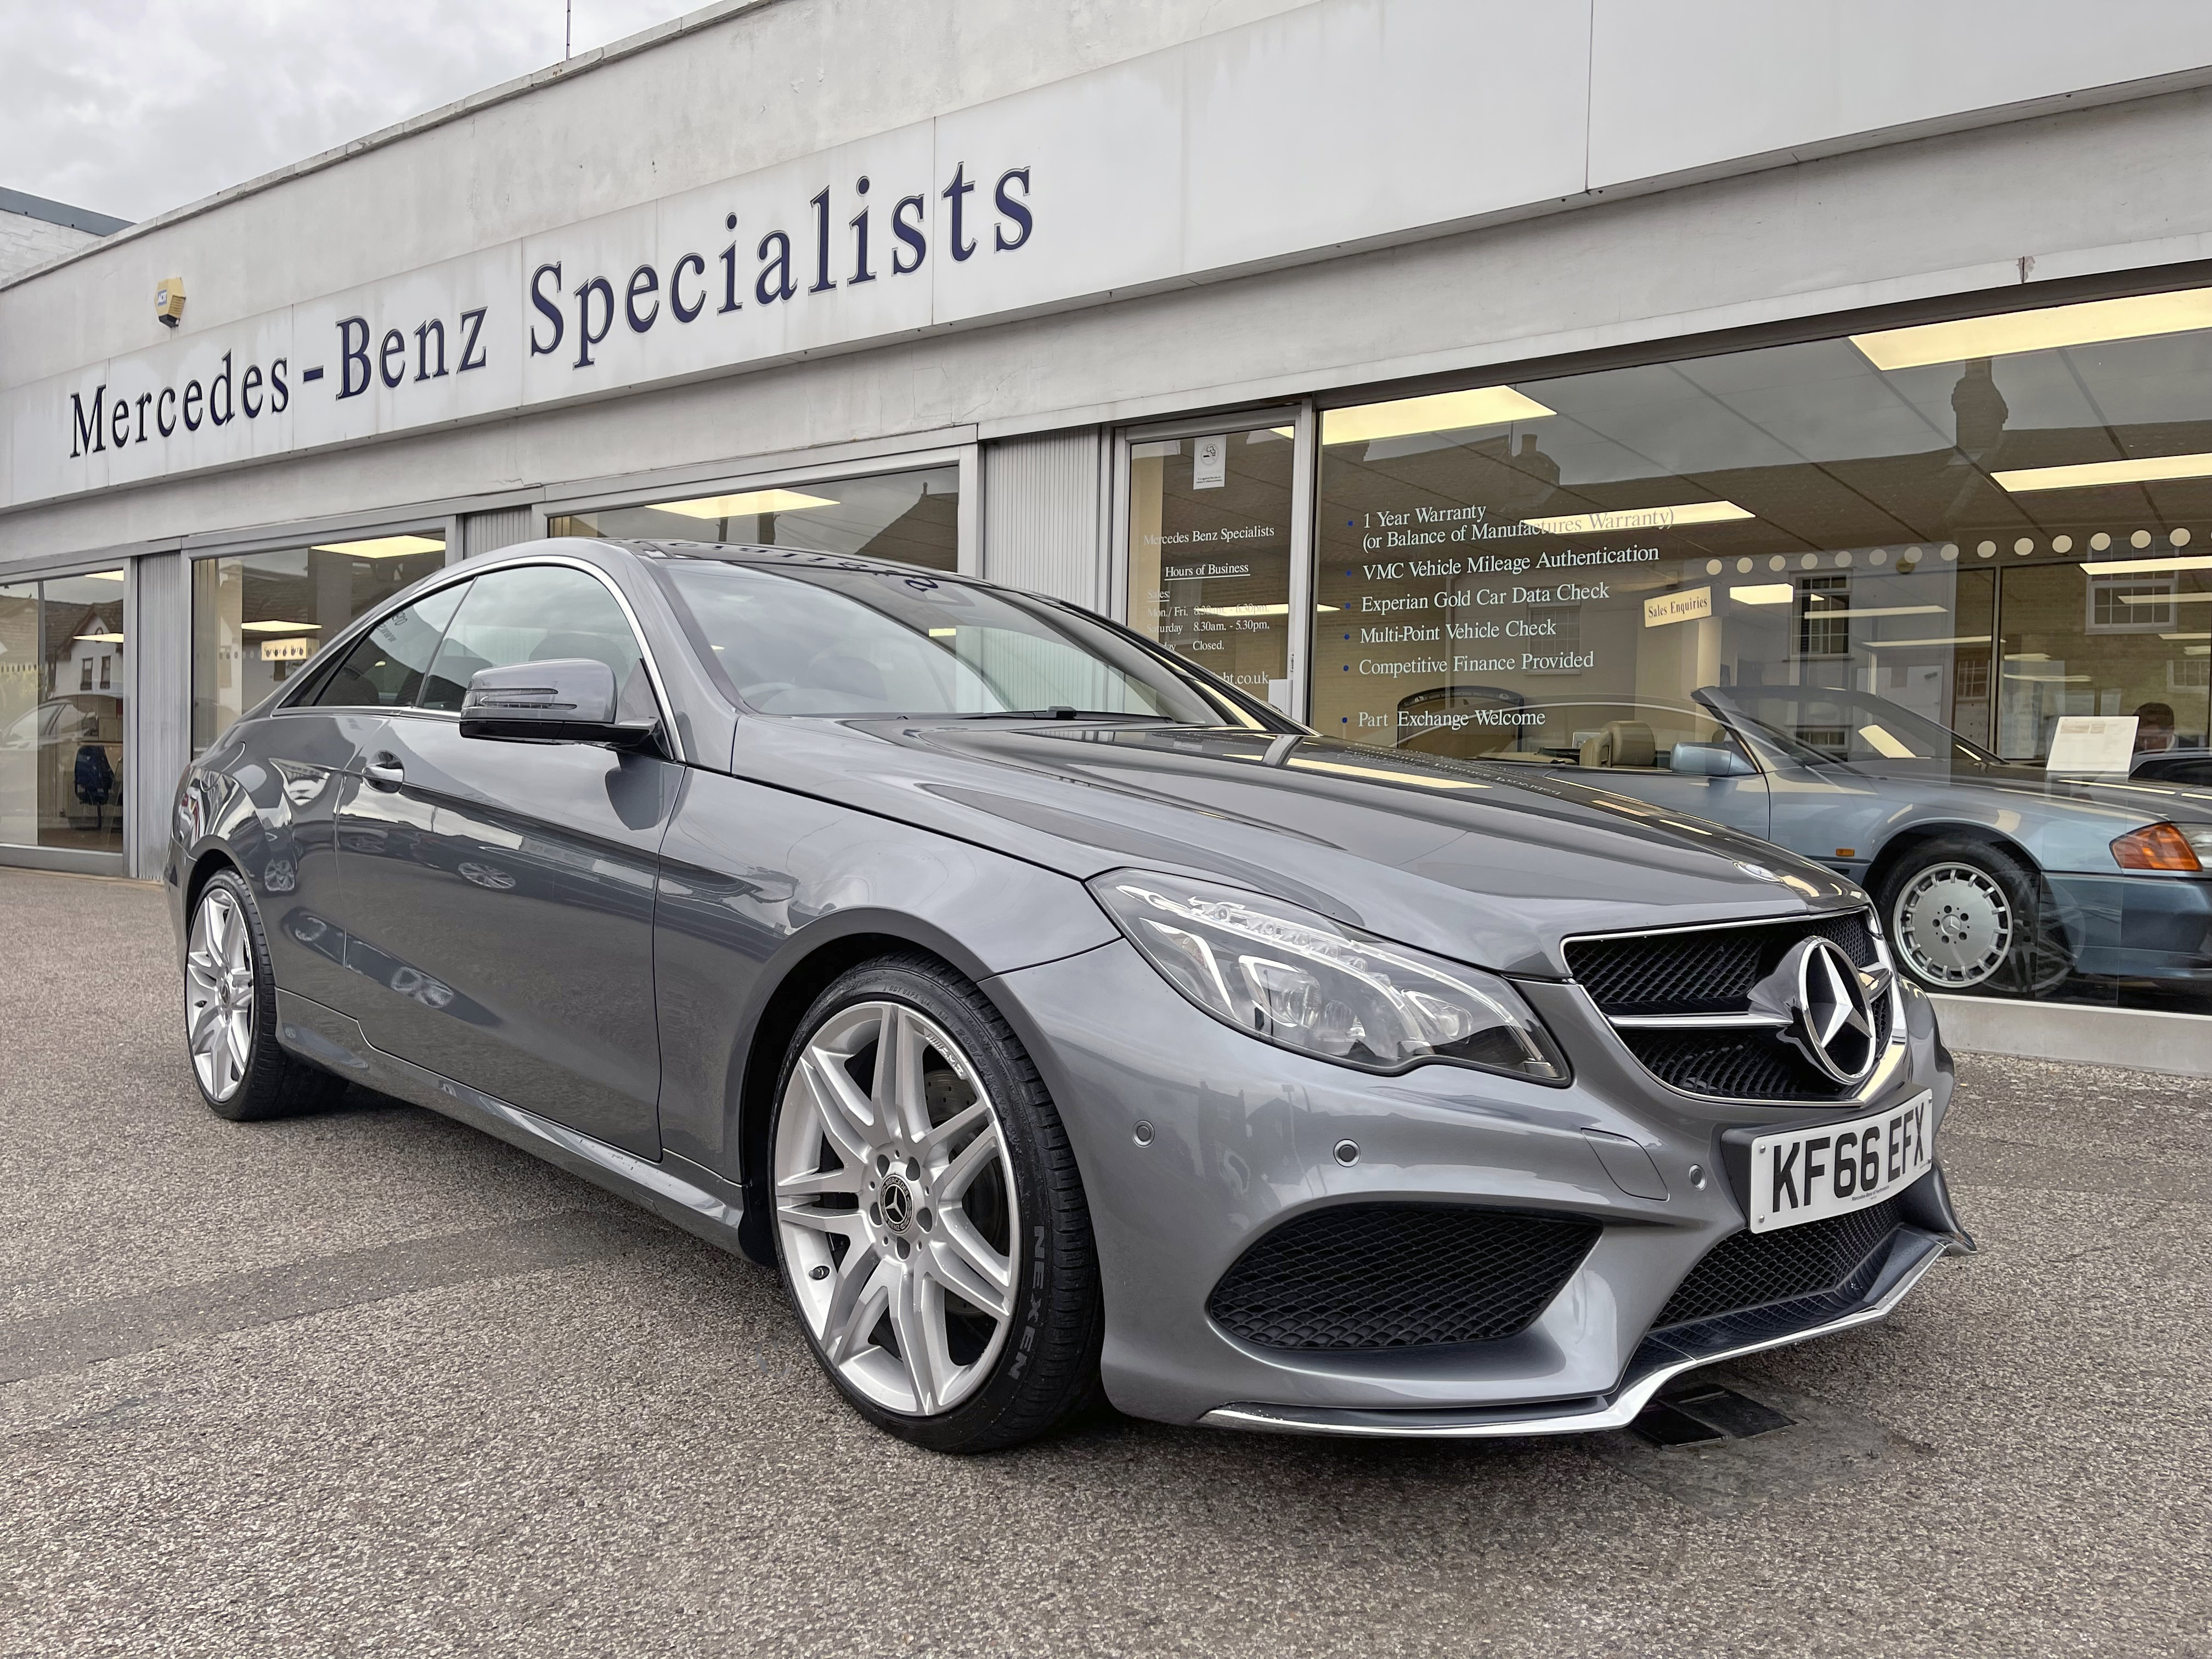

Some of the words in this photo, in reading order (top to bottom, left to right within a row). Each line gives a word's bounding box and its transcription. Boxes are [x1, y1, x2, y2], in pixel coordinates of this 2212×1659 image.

[157, 292, 167, 303] ADT
[70, 306, 488, 458] Mercedes-Benz
[530, 160, 1033, 370] Specialists
[1364, 513, 1371, 528] 1
[1376, 511, 1410, 527] Year
[1415, 504, 1487, 523] Warranty
[1143, 532, 1189, 545] Mercedes
[1192, 531, 1218, 542] Benz
[1221, 526, 1275, 543] Specialists
[1363, 533, 1382, 553] (or
[1387, 530, 1446, 547] Balance
[1451, 524, 1467, 541] of
[1471, 519, 1582, 540] Manufactures
[1588, 506, 1674, 530] Warranty)
[1165, 566, 1193, 577] Hours
[1195, 564, 1206, 575] of
[1208, 563, 1249, 574] Business
[1363, 562, 1404, 580] VMC
[1409, 558, 1462, 577] Vehicle
[1467, 555, 1531, 575] Mileage
[1536, 544, 1660, 569] Authentication
[1147, 590, 1171, 599] Sales:
[1361, 594, 1428, 615] Experian
[1434, 590, 1471, 608] Gold
[1476, 589, 1506, 605] Car
[1512, 587, 1551, 604] Data
[1556, 582, 1610, 601] Check
[1174, 606, 1188, 616] Fri.
[1649, 603, 1668, 618] Sales
[1671, 596, 1707, 614] Enquiries
[1147, 623, 1183, 635] Saturday
[1193, 621, 1227, 631] 8.30am.
[1235, 620, 1270, 632] 5.30pm.
[1360, 624, 1440, 644] Multi-Point
[1445, 621, 1499, 640] Vehicle
[1505, 618, 1557, 637] Check
[1193, 640, 1224, 651] Closed.
[1359, 657, 1447, 678] Competitive
[1453, 654, 1516, 672] Finance
[1521, 651, 1594, 670] Provided
[1358, 712, 1389, 727] Part
[1397, 710, 1469, 730] Exchange
[1475, 708, 1546, 726] Welcome
[1773, 1126, 1880, 1213] KF66
[1888, 1102, 1925, 1183] EFX
[885, 1177, 909, 1196] MERCEDES
[888, 1220, 900, 1231] BENZ
[1008, 1226, 1045, 1380] NEXEN
